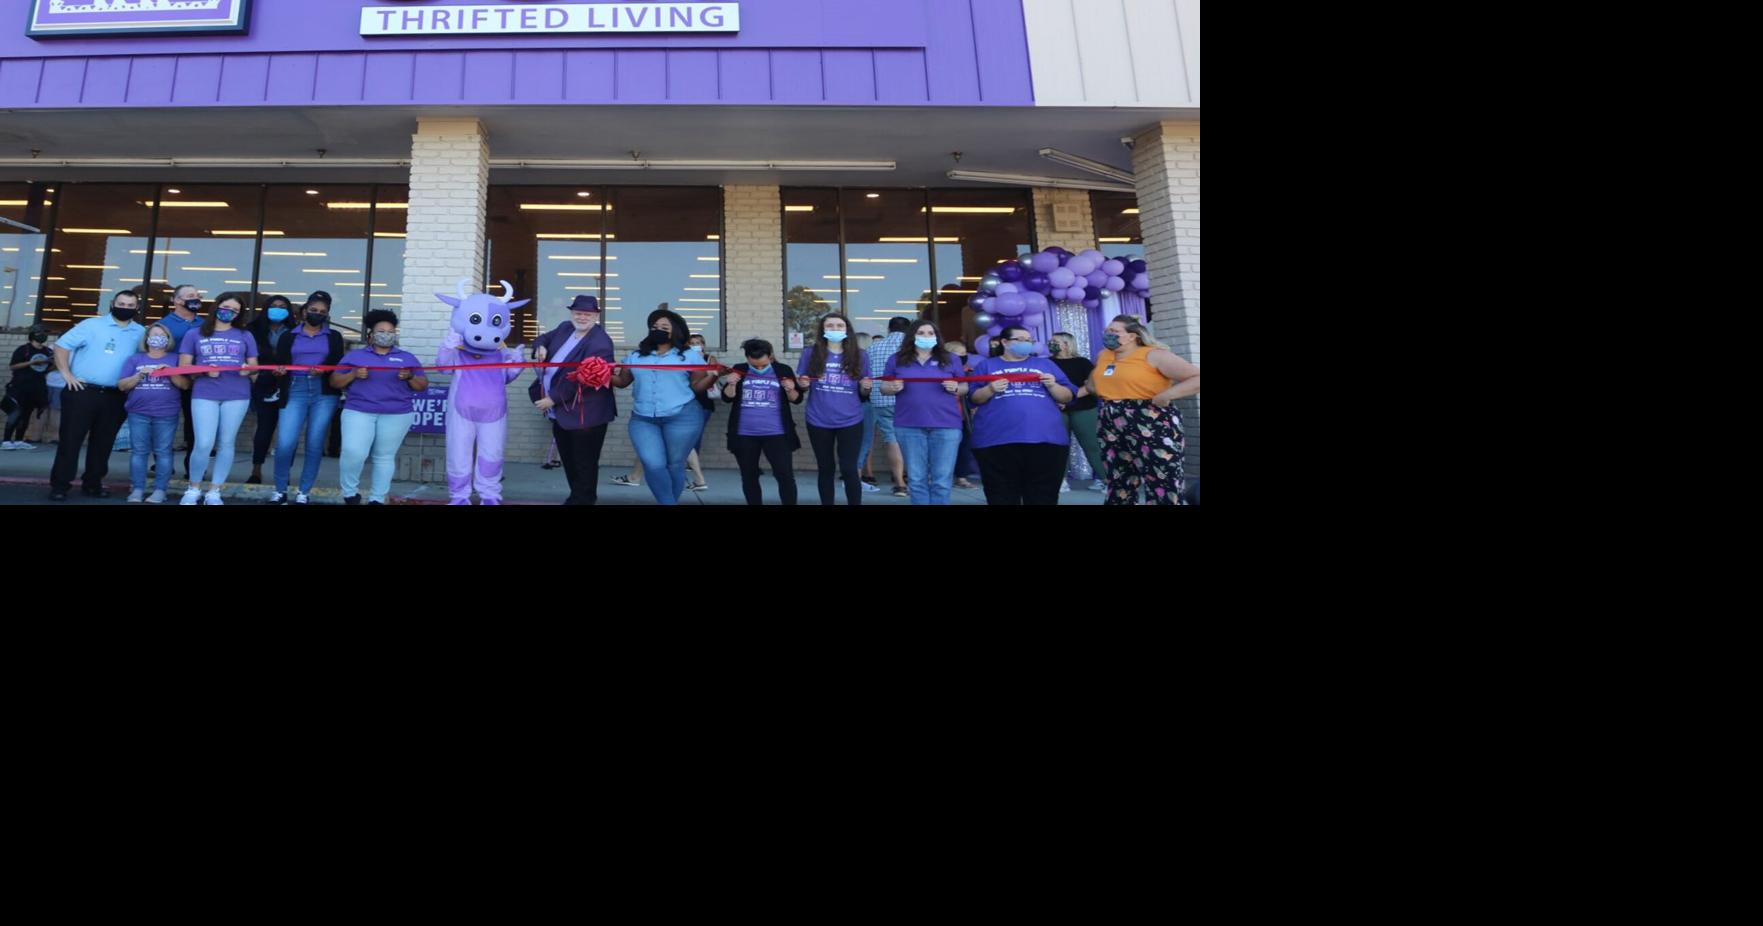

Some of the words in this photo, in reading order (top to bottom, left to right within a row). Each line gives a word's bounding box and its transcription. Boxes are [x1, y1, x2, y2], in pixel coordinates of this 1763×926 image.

[377, 8, 569, 30] THRIFTED
[588, 6, 724, 28] LIVING
[411, 398, 449, 412] WE'
[411, 411, 444, 426] OPE
